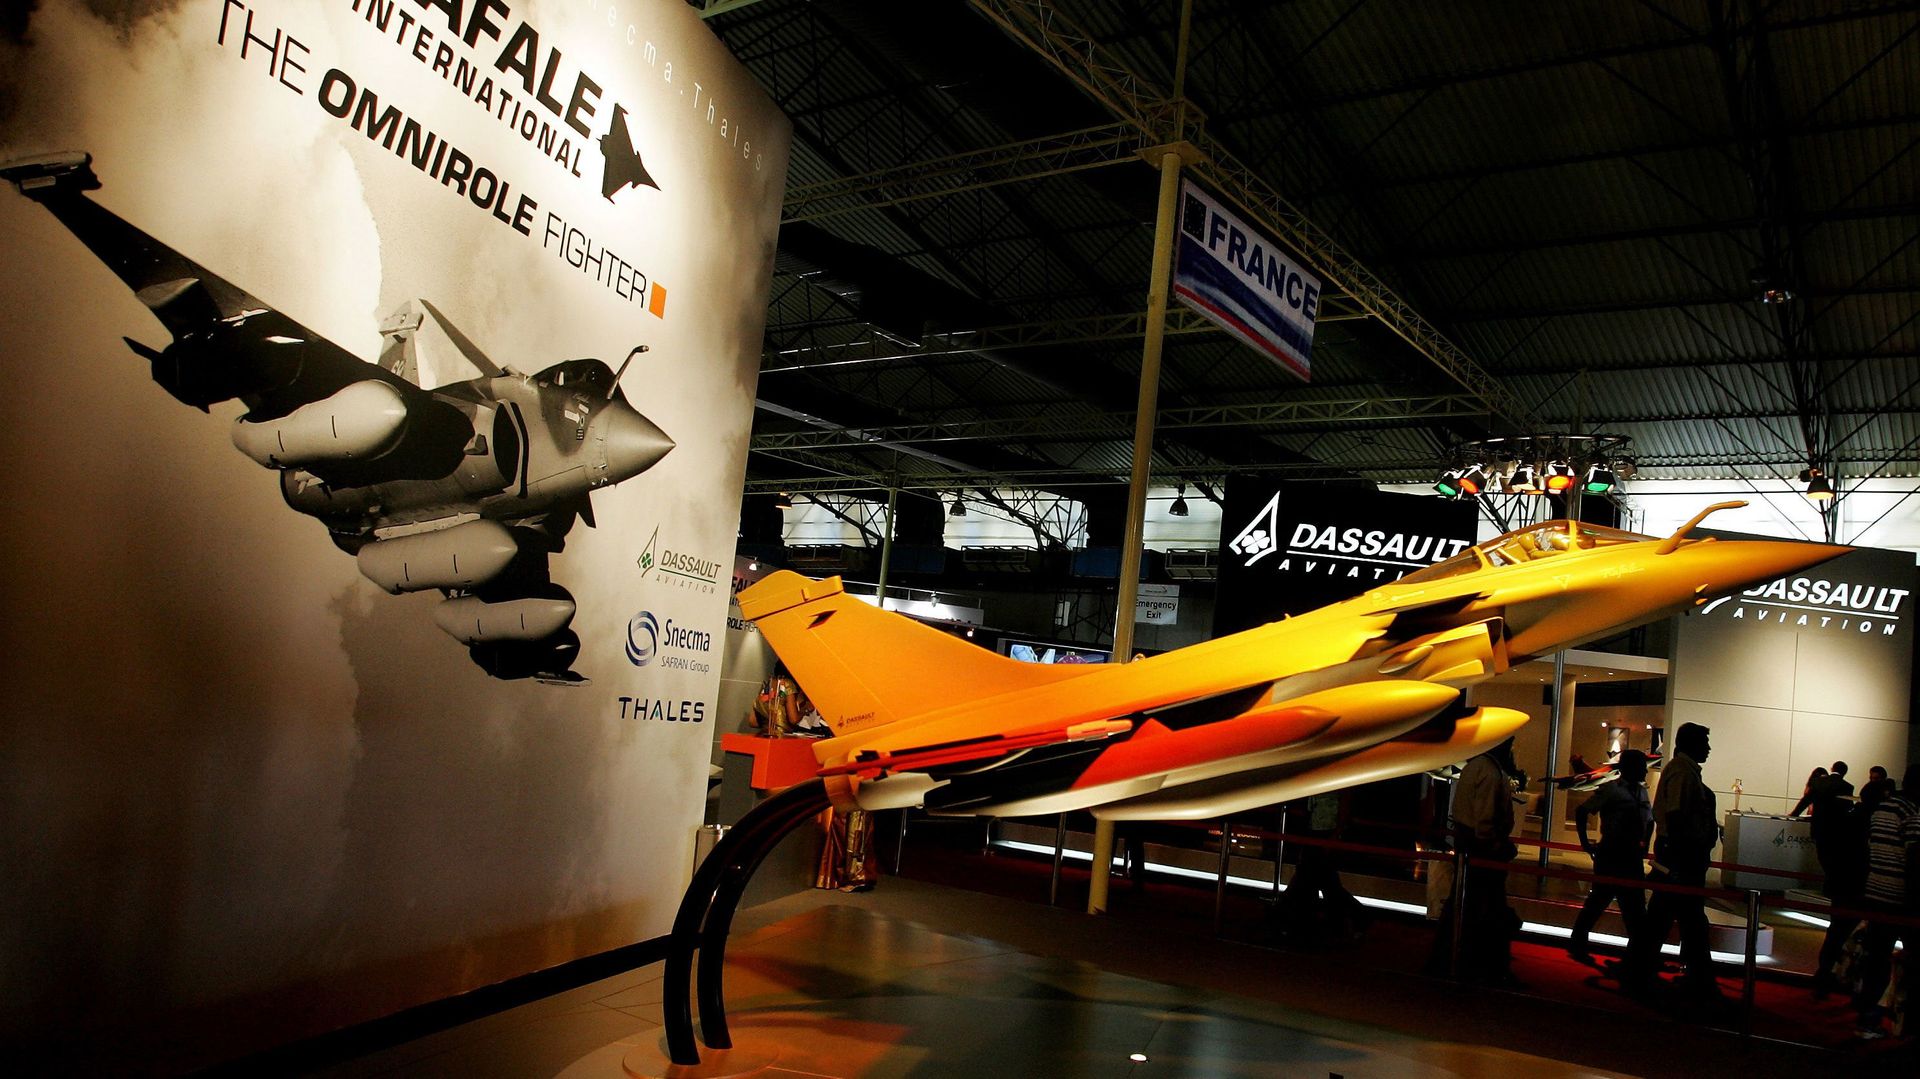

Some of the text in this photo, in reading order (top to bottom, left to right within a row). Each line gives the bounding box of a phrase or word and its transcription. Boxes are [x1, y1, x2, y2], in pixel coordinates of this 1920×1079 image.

[218, 0, 647, 309] THE OMNIROLE FIGHTER
[1208, 211, 1319, 321] FRANCE
[1289, 523, 1470, 562] DASSAULT
[661, 549, 722, 579] DASSAULT
[656, 574, 716, 595] AVIATION
[1146, 610, 1162, 619] Exit
[1733, 607, 1897, 636] AVIATION
[663, 618, 711, 652] Snecma
[661, 655, 710, 676] SAFRAN Group
[618, 696, 705, 723] THALES
